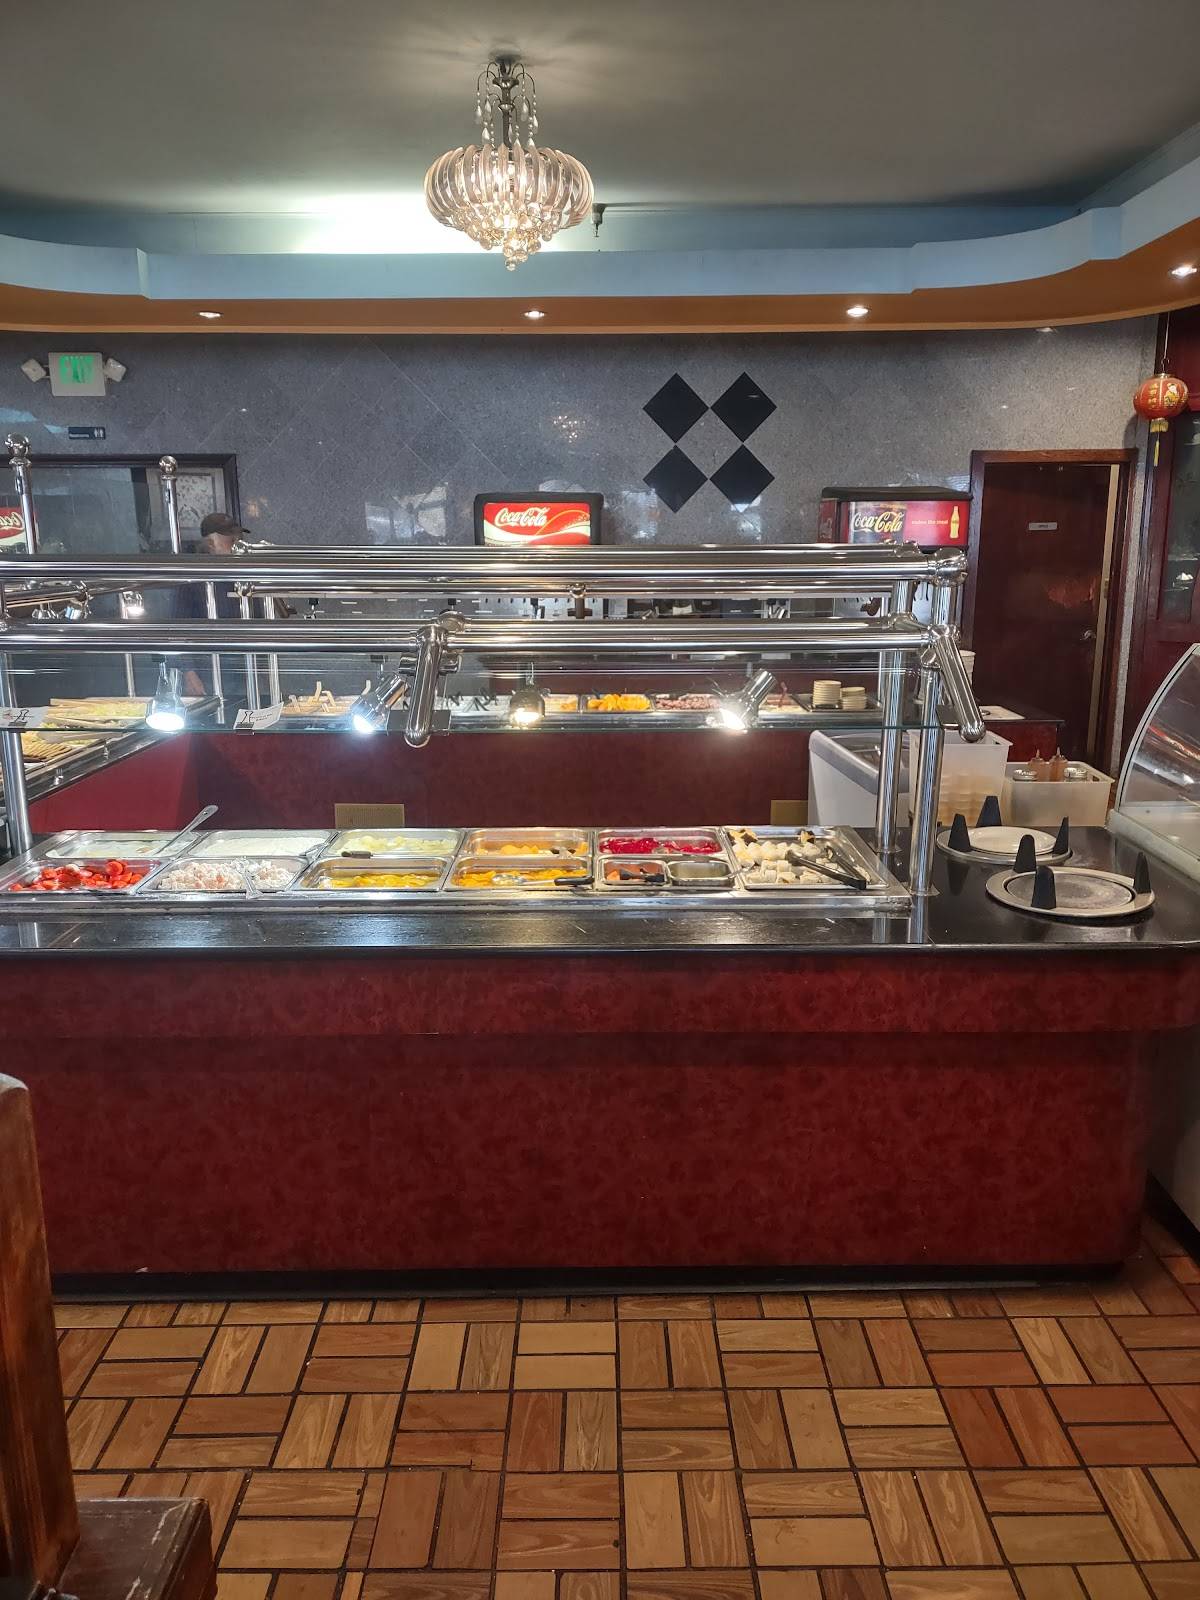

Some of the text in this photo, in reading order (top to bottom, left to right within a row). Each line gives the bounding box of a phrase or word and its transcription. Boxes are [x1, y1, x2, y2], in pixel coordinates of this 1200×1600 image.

[59, 355, 93, 384] EXIT
[494, 507, 550, 527] Coca-Cola
[853, 510, 905, 533] Coca-Cola
